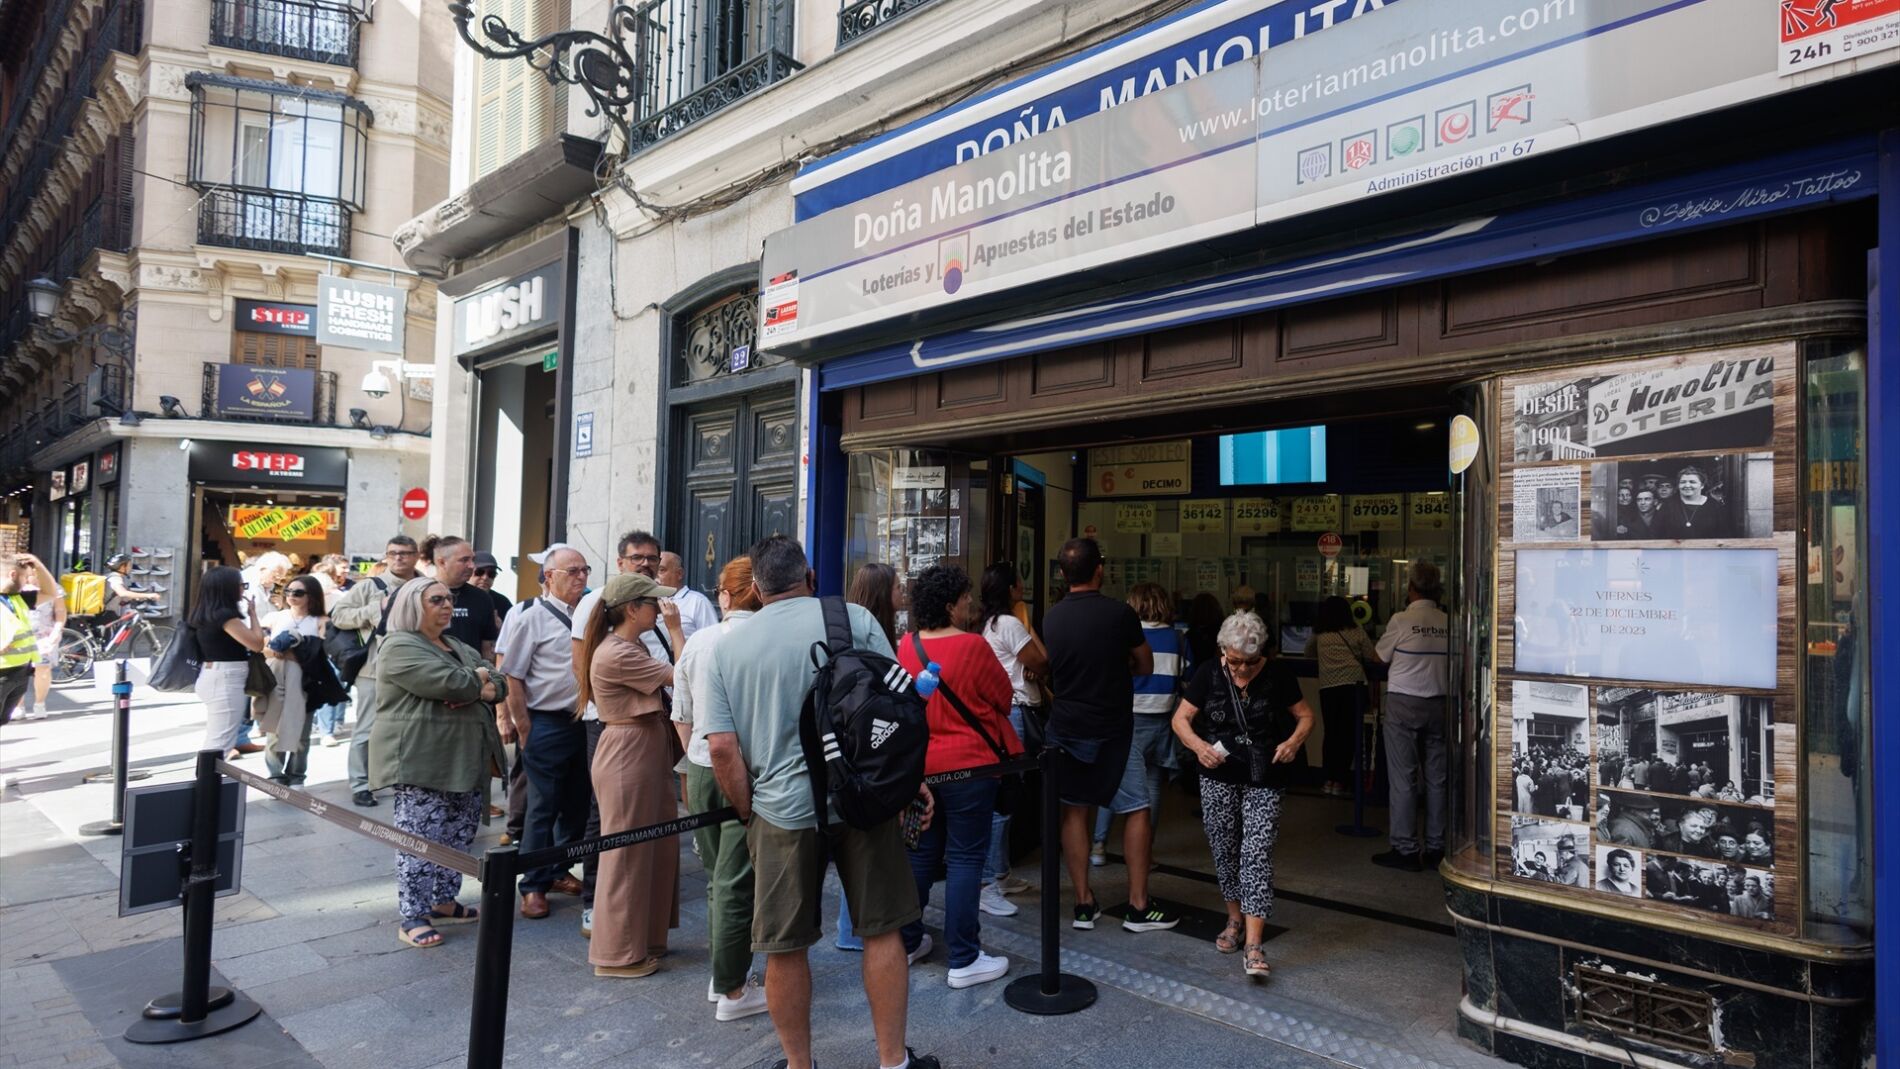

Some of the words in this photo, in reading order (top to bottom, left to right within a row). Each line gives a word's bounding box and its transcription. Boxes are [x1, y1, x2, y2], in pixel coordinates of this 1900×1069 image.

[1857, 35, 1878, 47] 900
[1789, 41, 1831, 64] 24h
[1178, 0, 1577, 144] www.loteriamanolita.com
[1367, 153, 1484, 194] Administración
[1512, 138, 1536, 157] 67
[854, 199, 921, 249] Doña
[930, 148, 1071, 224] Manolita
[862, 265, 921, 297] Loterías
[924, 262, 935, 284] y
[973, 225, 1057, 267] Apuestas
[1063, 211, 1093, 240] del
[1100, 191, 1175, 231] Estado
[329, 287, 393, 311] LUSH
[466, 276, 543, 343] LUSH
[255, 306, 305, 325] STEP
[329, 303, 393, 324] FRESH
[328, 316, 392, 333] HANDMADE
[328, 325, 392, 341] COSMETICS
[734, 350, 745, 366] 22
[1523, 393, 1580, 416] DESDE
[1591, 379, 1774, 443] LOTERIA
[1531, 425, 1571, 446] 1904
[237, 451, 299, 471] STEP
[1101, 471, 1115, 493] 6
[1124, 467, 1135, 479] €
[1142, 478, 1182, 490] DECIMO
[1183, 509, 1222, 519] 36142
[1237, 508, 1278, 518] 25296
[1296, 504, 1336, 513] 24914
[1353, 504, 1398, 516] 87092
[1595, 591, 1653, 601] VIERNES
[1569, 607, 1583, 617] 22
[1585, 607, 1602, 617] DE
[1605, 608, 1677, 620] DICIEMBRE
[1600, 625, 1615, 634] DE
[1618, 625, 1647, 635] 2023
[871, 721, 900, 749] adidas
[566, 817, 699, 858] WWW.LOTERIAMANOLITA.COM
